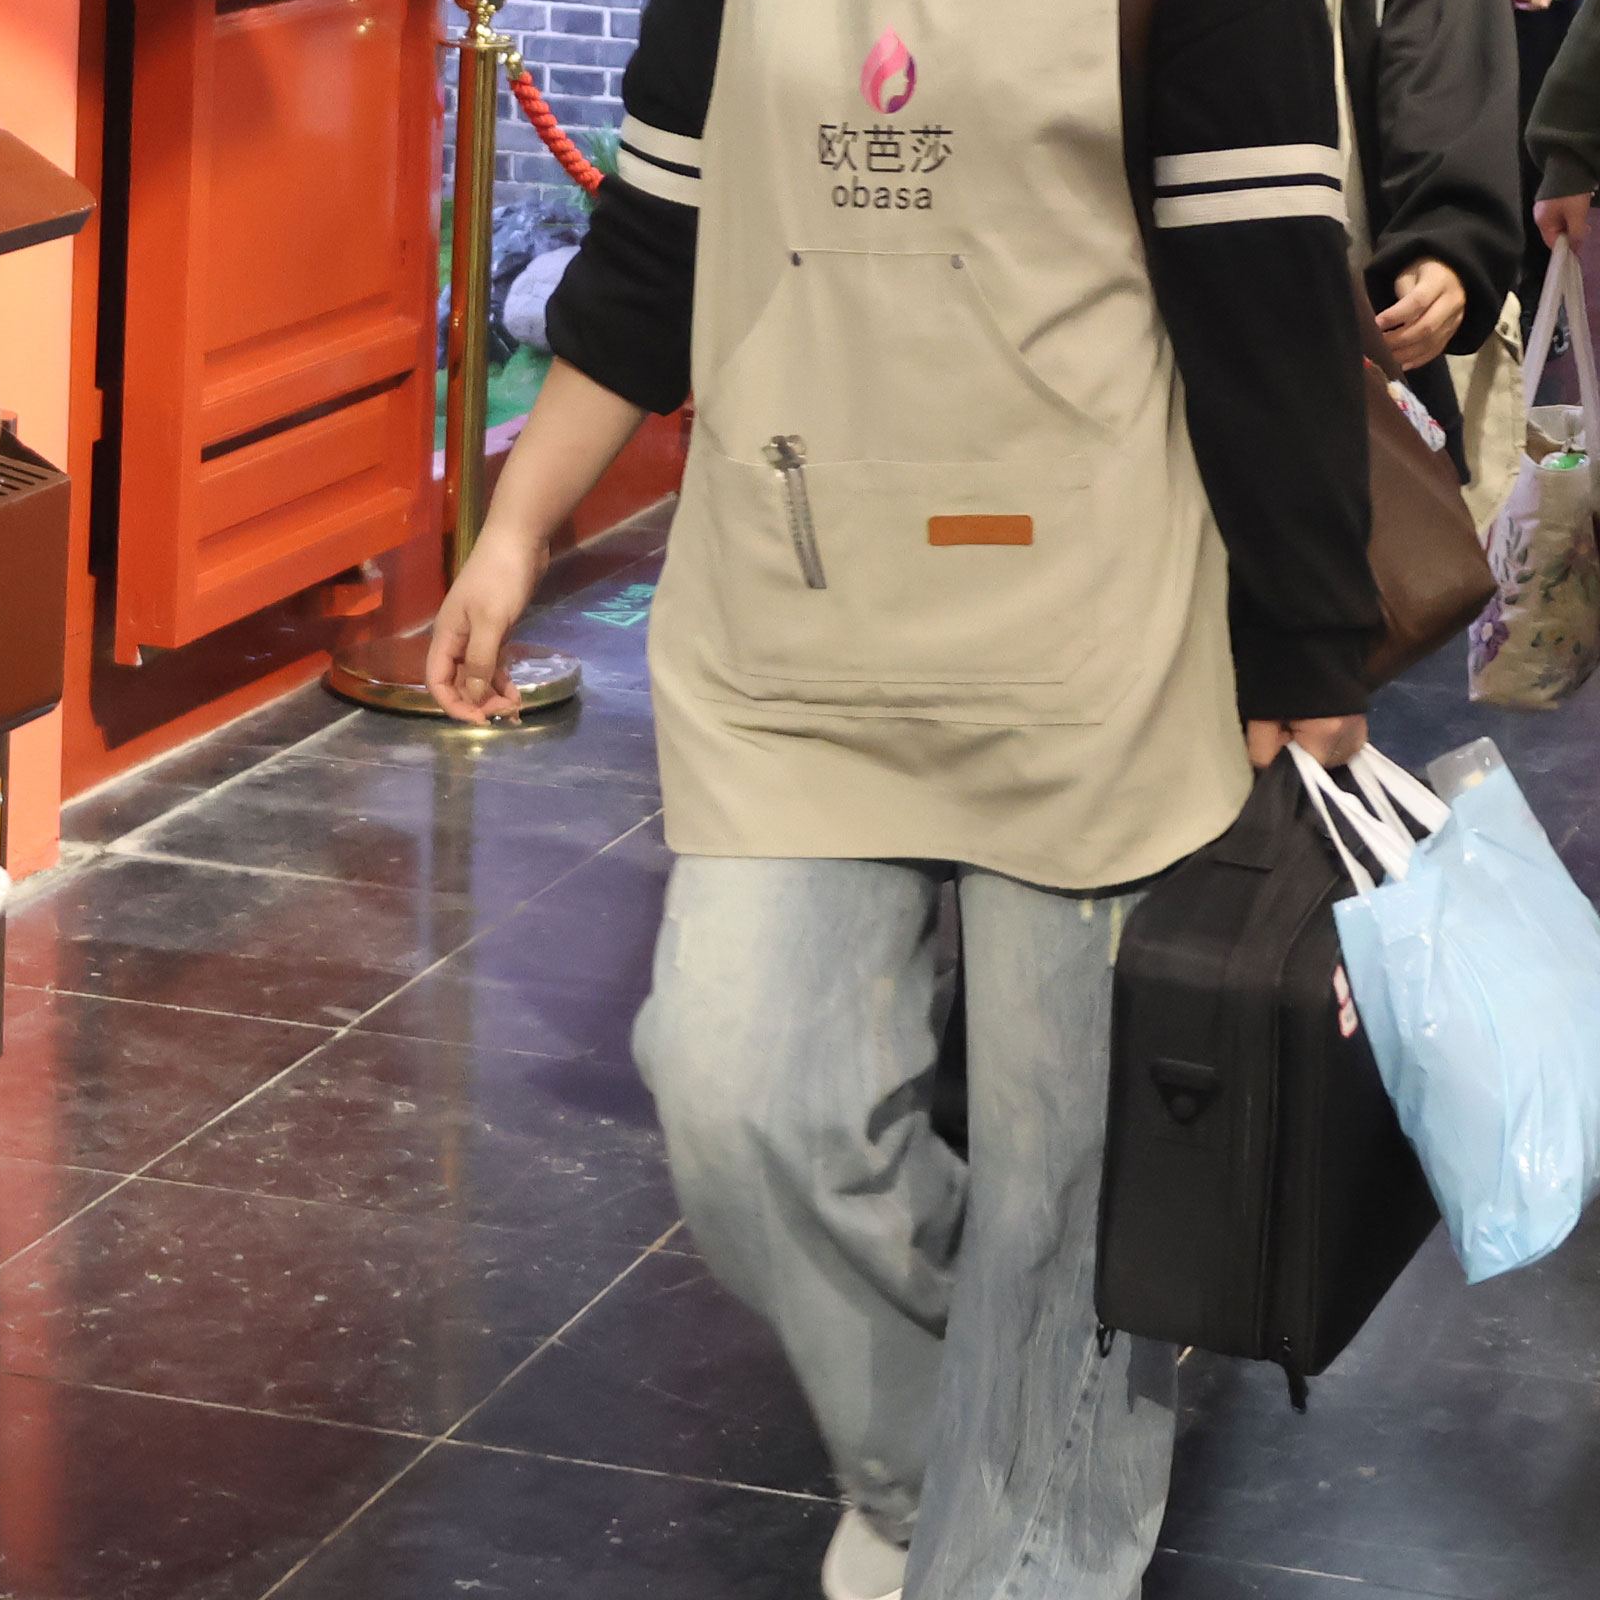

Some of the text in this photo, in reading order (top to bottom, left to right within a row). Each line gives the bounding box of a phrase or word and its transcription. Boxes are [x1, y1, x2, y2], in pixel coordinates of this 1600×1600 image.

[818, 122, 954, 173] 欧芭莎
[831, 175, 932, 209] obasa
